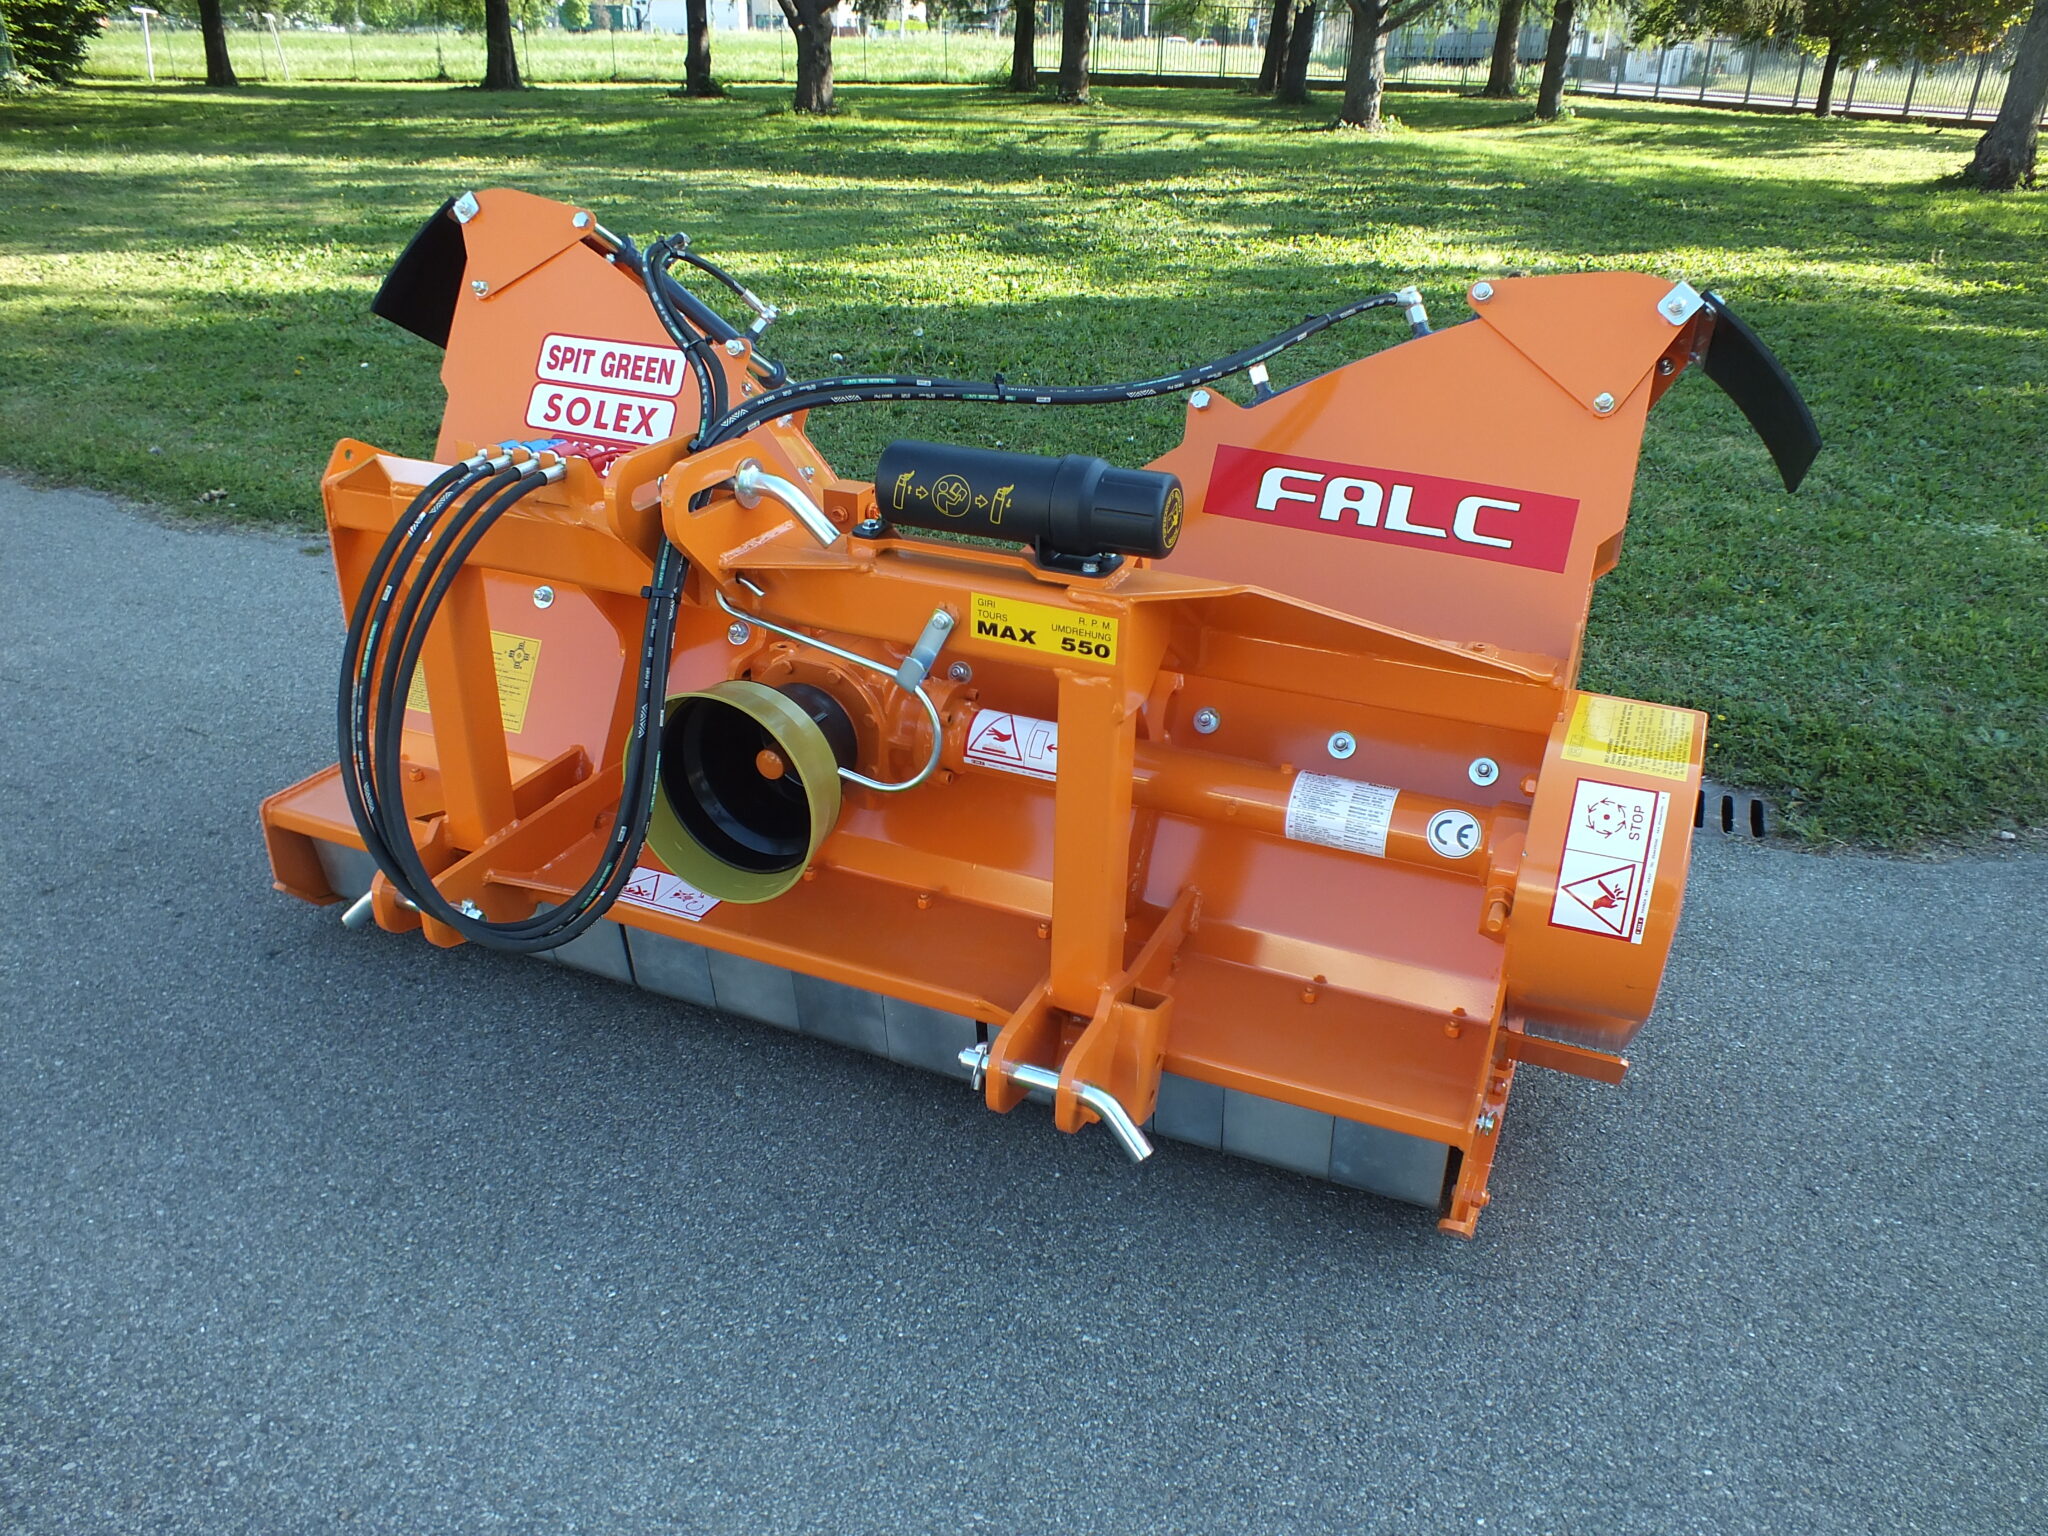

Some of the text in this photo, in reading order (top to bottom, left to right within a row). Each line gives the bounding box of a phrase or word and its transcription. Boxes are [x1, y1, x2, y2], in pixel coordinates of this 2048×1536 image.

[546, 344, 676, 386] SPIT GREEN
[543, 393, 659, 438] SOLEX
[1255, 466, 1522, 550] FALC
[977, 598, 996, 609] GIRI
[977, 609, 1008, 622] TOURS
[977, 620, 1111, 659] MAX 550
[1051, 624, 1112, 642] UMDREHUNG
[1434, 819, 1474, 850] CE
[1628, 805, 1645, 841] STOP
